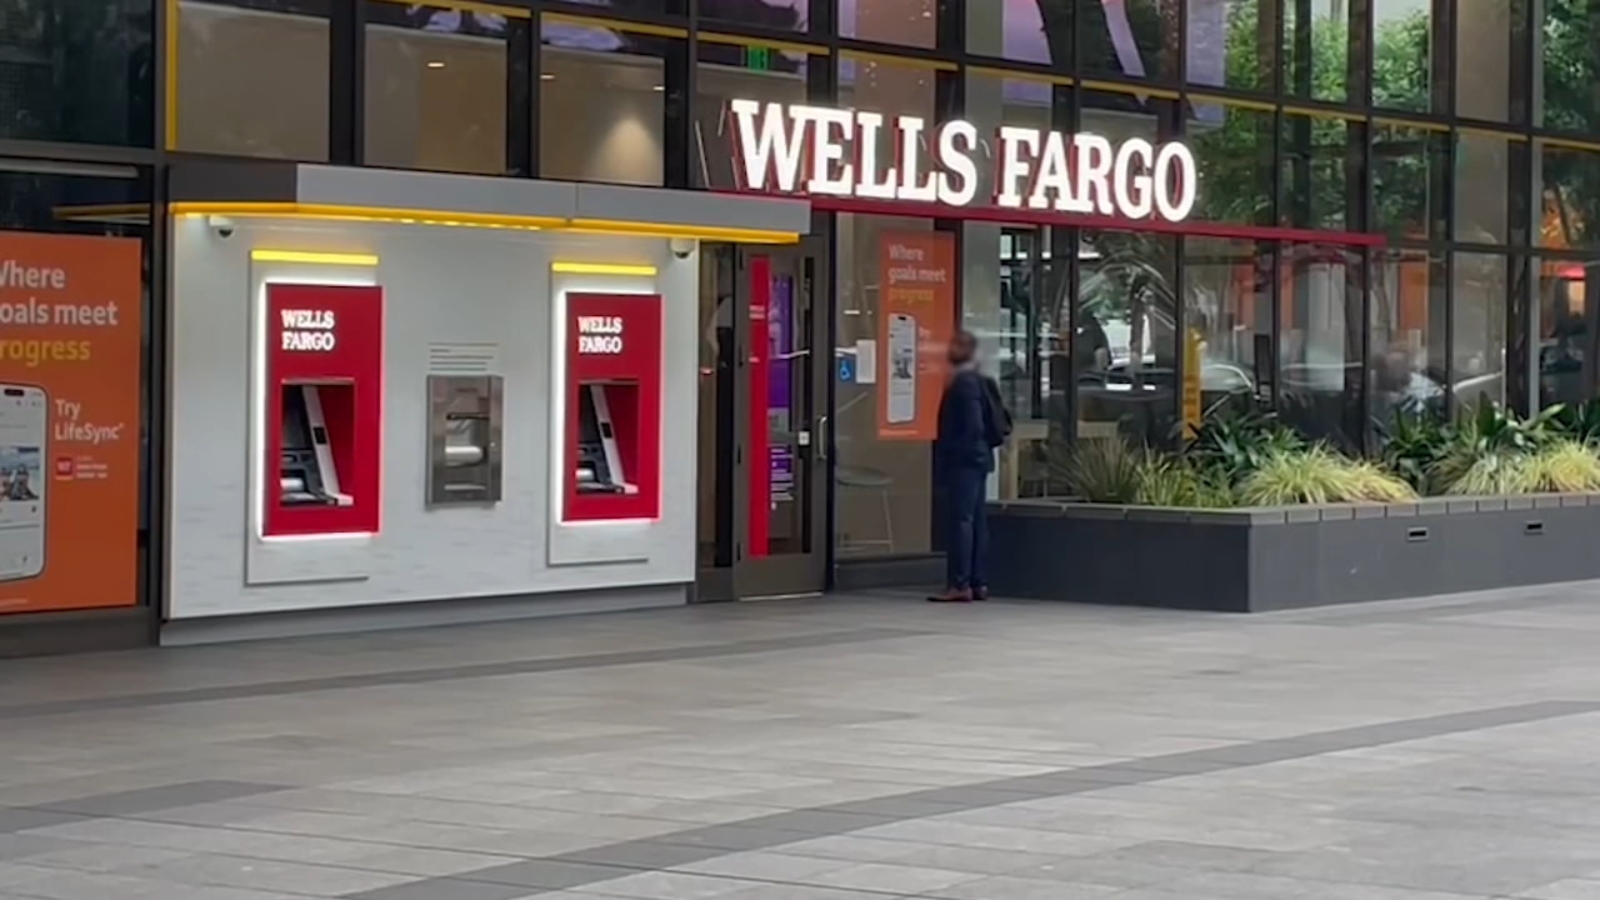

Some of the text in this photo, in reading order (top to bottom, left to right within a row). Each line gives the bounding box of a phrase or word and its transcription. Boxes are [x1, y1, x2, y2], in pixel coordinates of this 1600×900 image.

[732, 99, 1197, 222] WELLS FARGO
[888, 245, 924, 261] Where
[888, 266, 946, 284] goals meet
[0, 297, 118, 325] oals meet
[281, 309, 335, 329] WELLS
[578, 316, 622, 333] WELLS
[281, 331, 335, 351] FARGO
[578, 336, 622, 353] FARGO
[0, 340, 91, 367] rogress
[55, 400, 81, 420] Try
